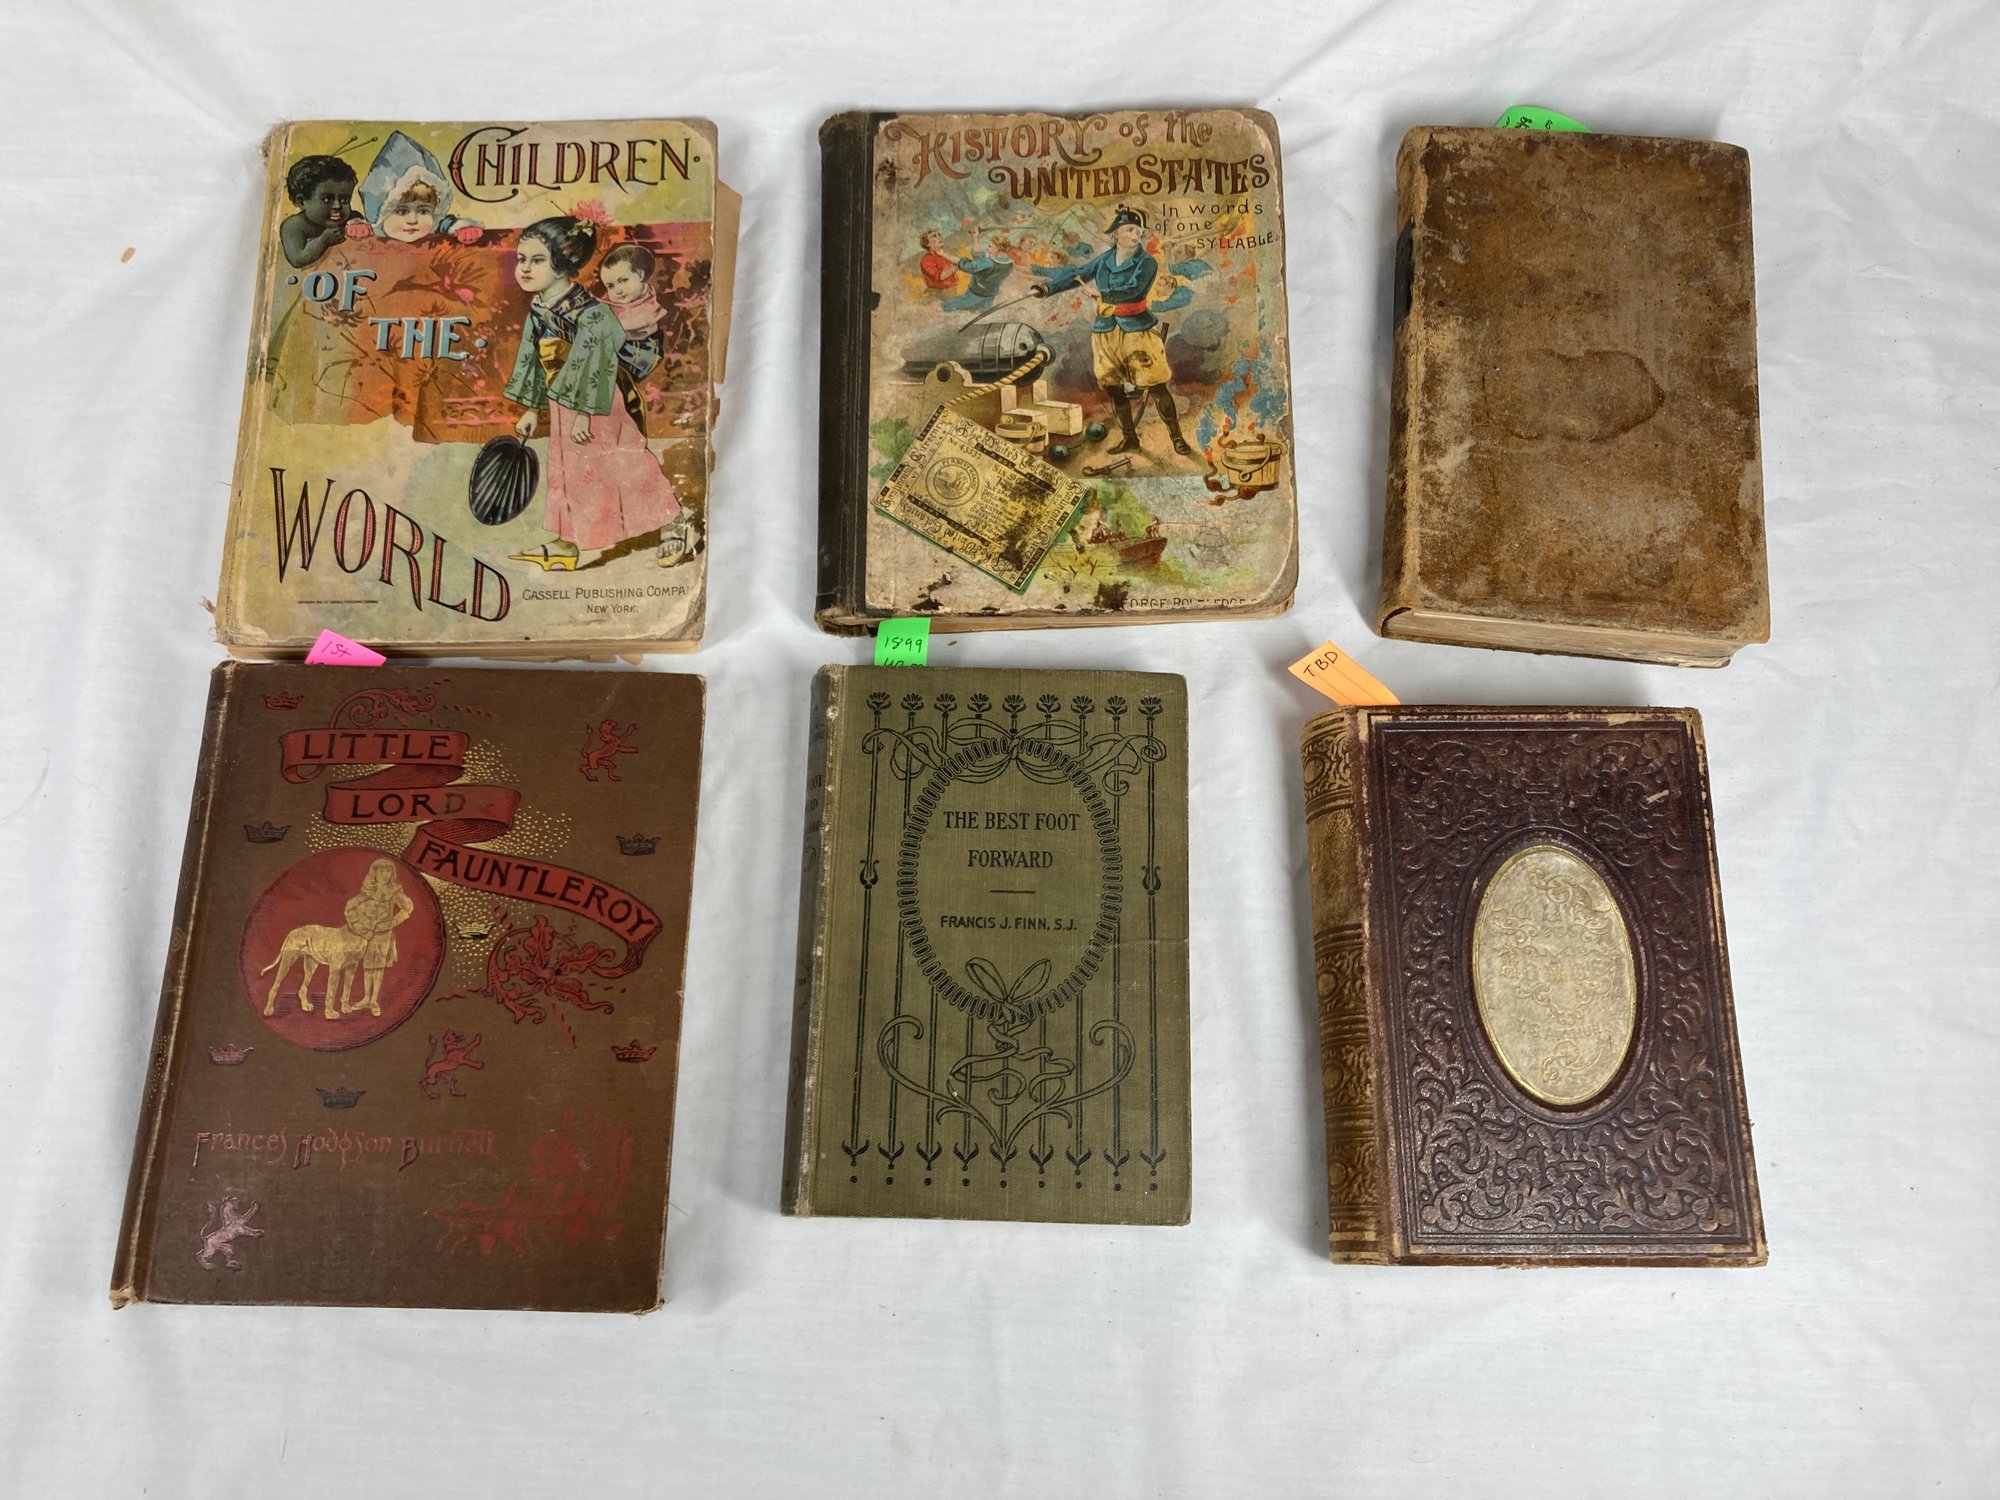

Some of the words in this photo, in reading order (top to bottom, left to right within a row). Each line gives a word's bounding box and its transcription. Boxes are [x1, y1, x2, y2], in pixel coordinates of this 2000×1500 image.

[884, 115, 1107, 189] HISTORY
[1119, 114, 1149, 147] of
[1165, 112, 1213, 148] the
[448, 126, 691, 204] CHILDREN
[988, 160, 1131, 207] UNITED
[1137, 153, 1272, 197] STATES
[1162, 202, 1180, 219] In
[1189, 201, 1265, 217] words
[1154, 219, 1170, 236] of
[1176, 219, 1214, 232] one
[303, 269, 378, 312] OF
[368, 316, 472, 361] THE
[269, 467, 511, 622] WORLD
[522, 588, 571, 600] CASSELL
[575, 587, 643, 600] PUBLISHING
[587, 603, 608, 614] NEW
[884, 636, 923, 654] 1899
[1302, 650, 1339, 677] TBD
[302, 732, 453, 761] LITTLE
[350, 792, 467, 819] LORD
[943, 811, 980, 829] THE
[984, 811, 1031, 830] BEST
[1034, 812, 1081, 831] FOOT
[967, 849, 1055, 869] FORWARD
[415, 837, 656, 944] FAUNTLEROY
[940, 915, 996, 929] FRANCIS
[1000, 917, 1012, 930] J.
[1014, 917, 1051, 931] FINN,
[1054, 918, 1078, 931] S.J.
[193, 1126, 288, 1169] Frances
[292, 1127, 393, 1171] Hodgson
[398, 1128, 504, 1172] Burnett
